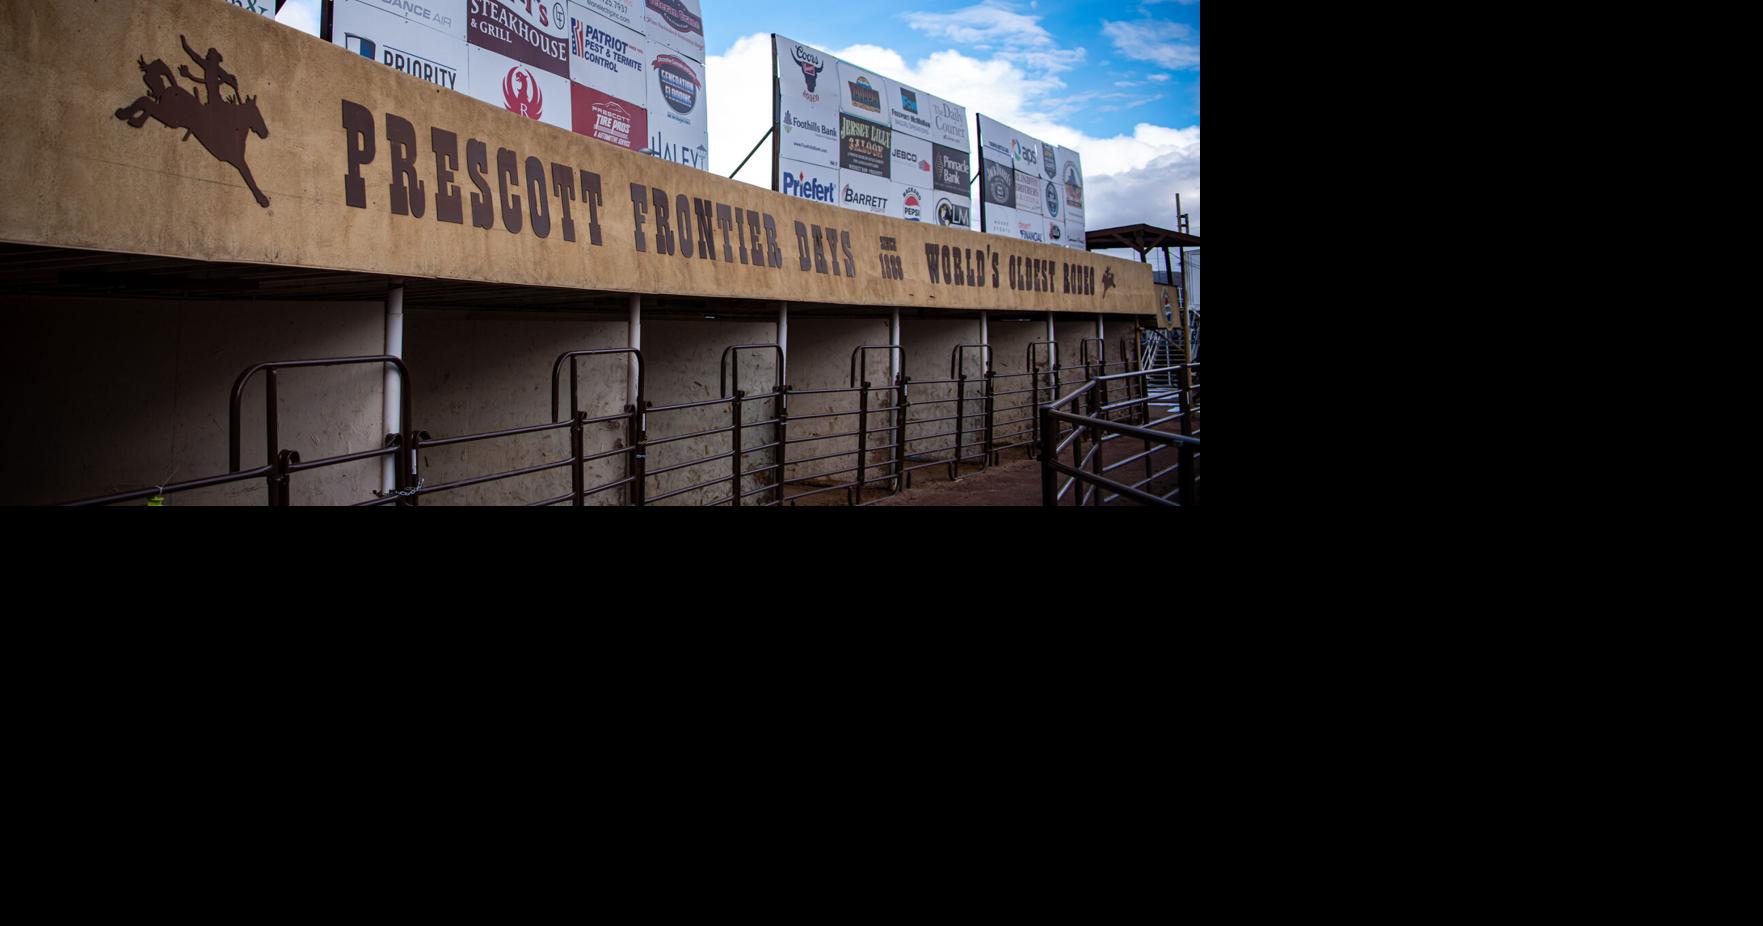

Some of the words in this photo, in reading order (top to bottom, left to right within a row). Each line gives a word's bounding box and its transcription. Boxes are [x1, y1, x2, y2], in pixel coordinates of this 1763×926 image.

[433, 13, 452, 28] AIR
[471, 0, 567, 61] STEAKHOUSE
[470, 18, 478, 28] &
[480, 21, 512, 44] GRILL
[586, 25, 628, 54] PATRIOT
[584, 51, 618, 73] CONTROL
[585, 39, 604, 54] PEST
[605, 46, 611, 57] &
[613, 51, 642, 71] TERMITE
[795, 45, 819, 65] Coors
[384, 50, 456, 90] PRIORITY
[592, 106, 630, 123] PRESCOTT
[595, 114, 612, 130] TIRE
[793, 117, 820, 134] Foothills
[821, 125, 837, 137] Bank
[841, 117, 870, 139] JERSEY
[871, 126, 890, 149] LILLY
[892, 149, 917, 163] JEBCO
[943, 155, 969, 174] Pinnacle
[1022, 147, 1037, 165] aps
[943, 168, 960, 185] Bank
[341, 99, 602, 246] PRESCOTT
[629, 182, 782, 269] FRONTIER
[794, 220, 856, 278] DAYS
[783, 171, 834, 203] Priefert
[845, 188, 888, 208] BARRETT
[904, 207, 920, 217] PEPSI
[925, 243, 999, 288] WORLD'S
[1009, 254, 1055, 293] OLDEST
[1063, 262, 1095, 296] RODEO
